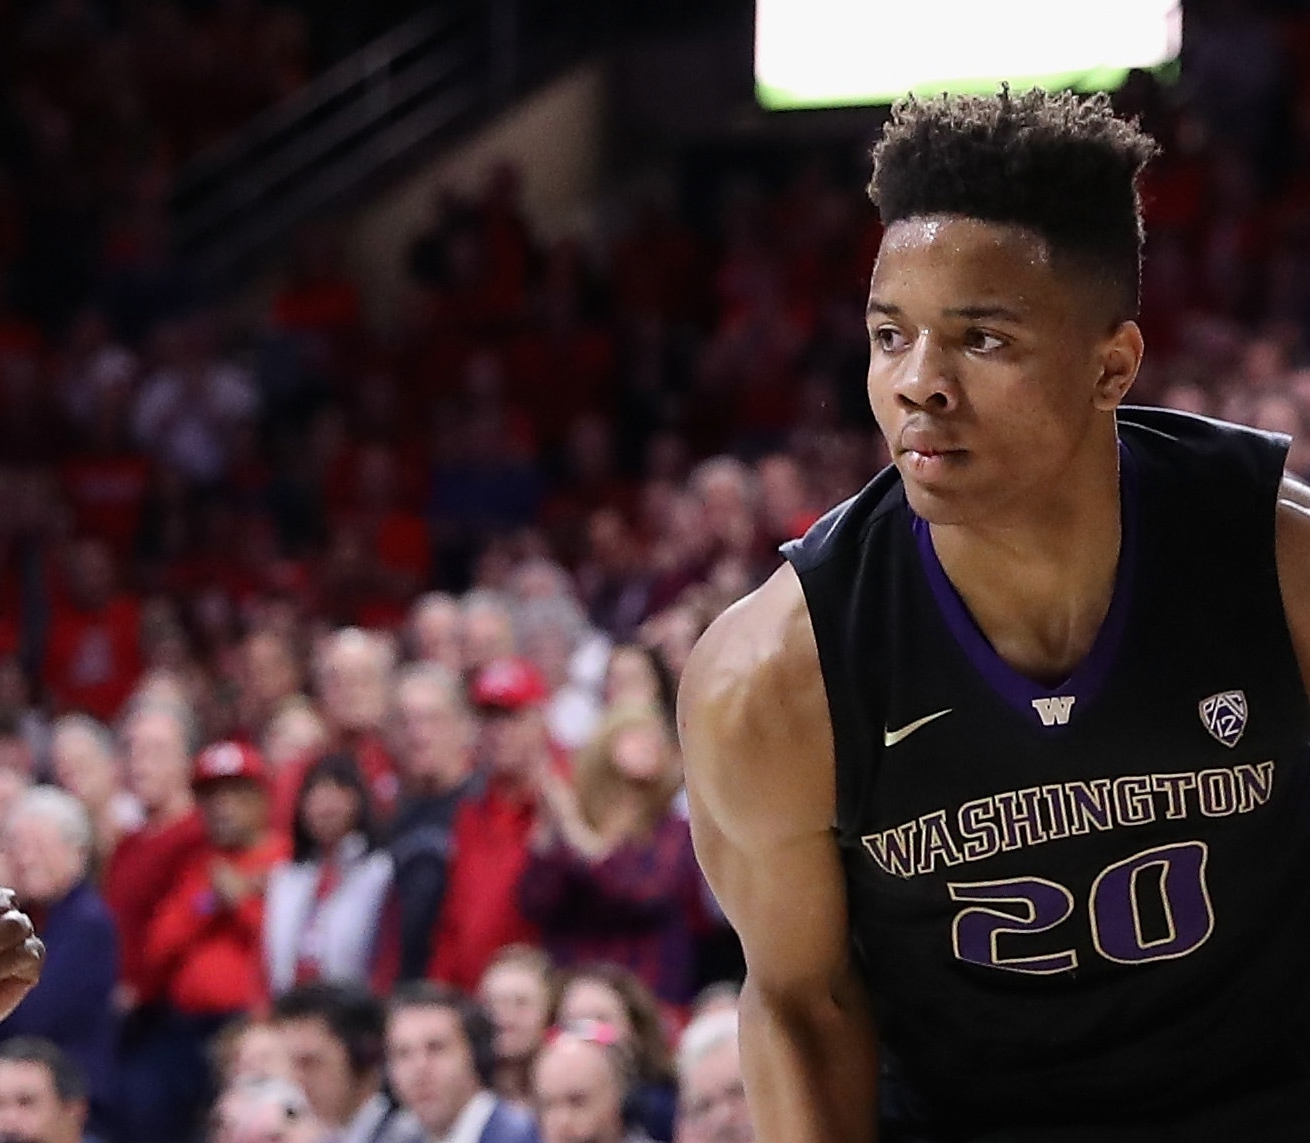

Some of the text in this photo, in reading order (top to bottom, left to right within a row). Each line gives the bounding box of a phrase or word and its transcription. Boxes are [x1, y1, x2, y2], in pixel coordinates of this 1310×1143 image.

[1032, 696, 1076, 726] W
[1203, 693, 1245, 729] PAC
[1216, 715, 1239, 738] 12
[862, 761, 1274, 878] WASHINGTON
[946, 840, 1215, 975] 20
